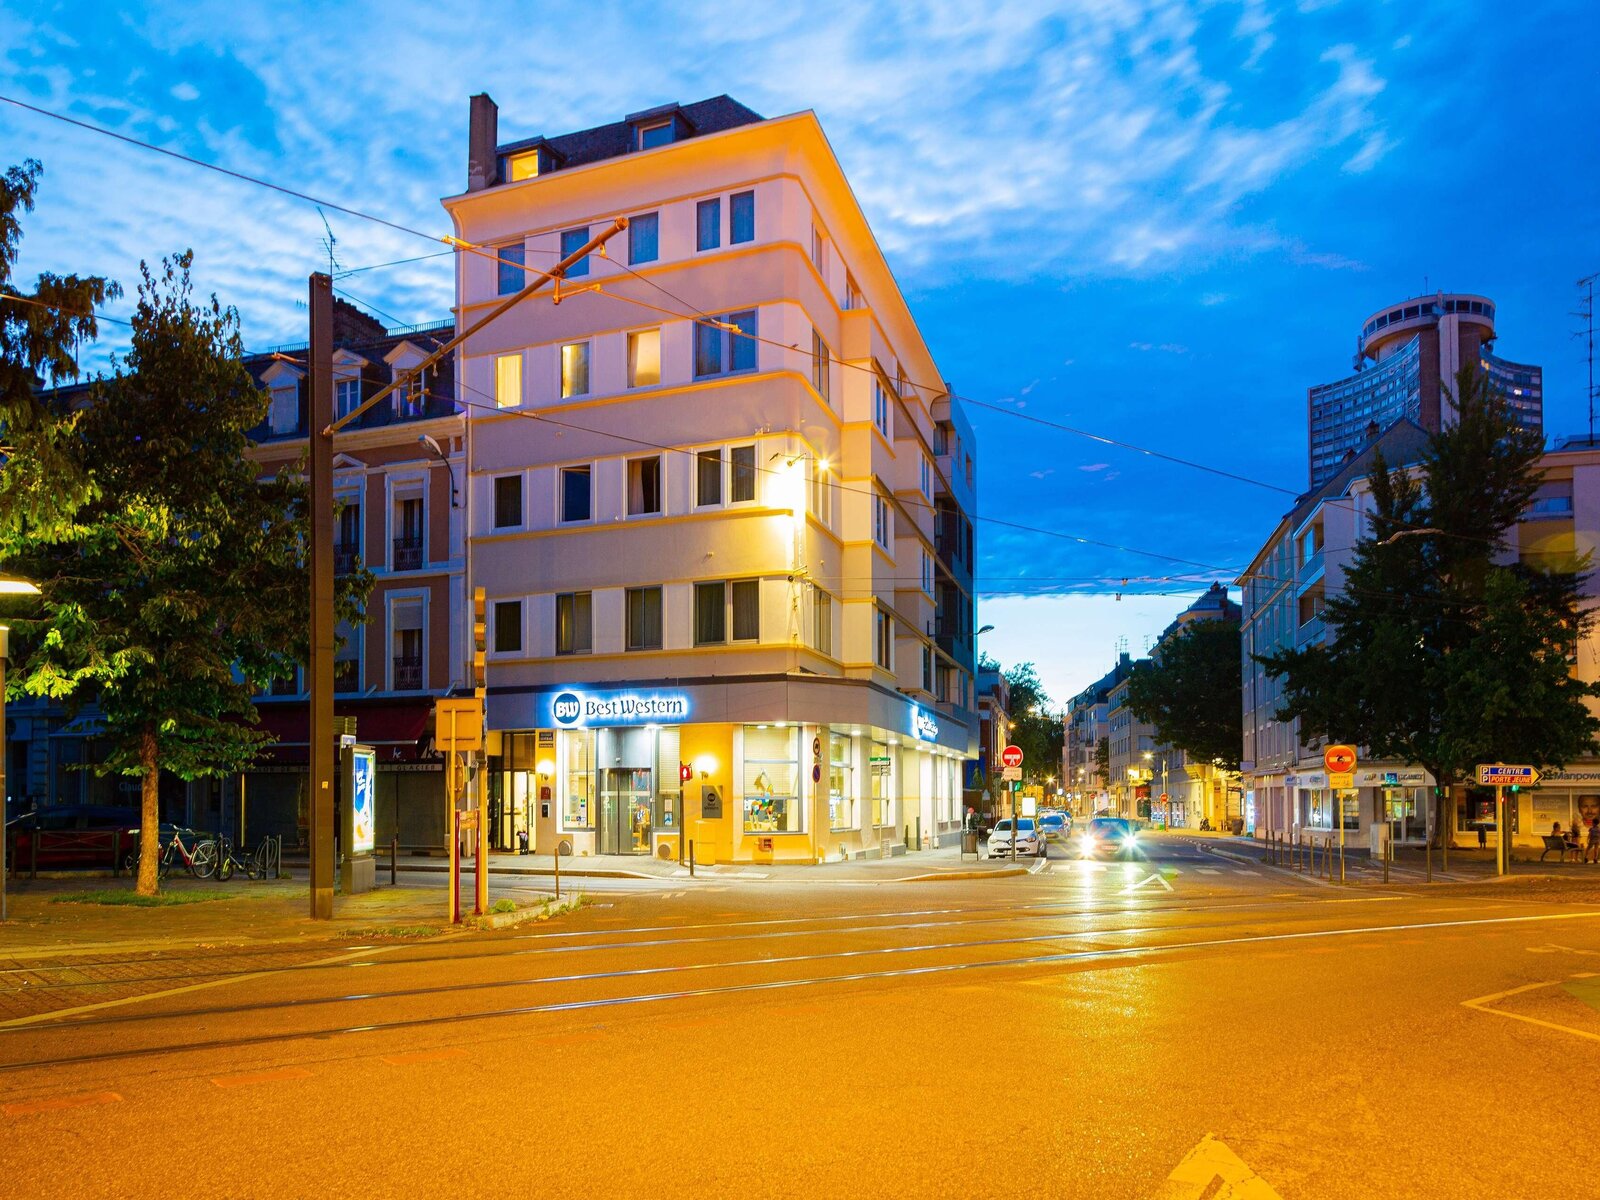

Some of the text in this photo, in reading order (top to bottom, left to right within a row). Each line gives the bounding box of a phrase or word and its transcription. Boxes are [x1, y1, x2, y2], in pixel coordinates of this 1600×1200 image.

[555, 701, 578, 717] BW
[585, 699, 683, 715] Best Western
[396, 764, 435, 772] GLACIER
